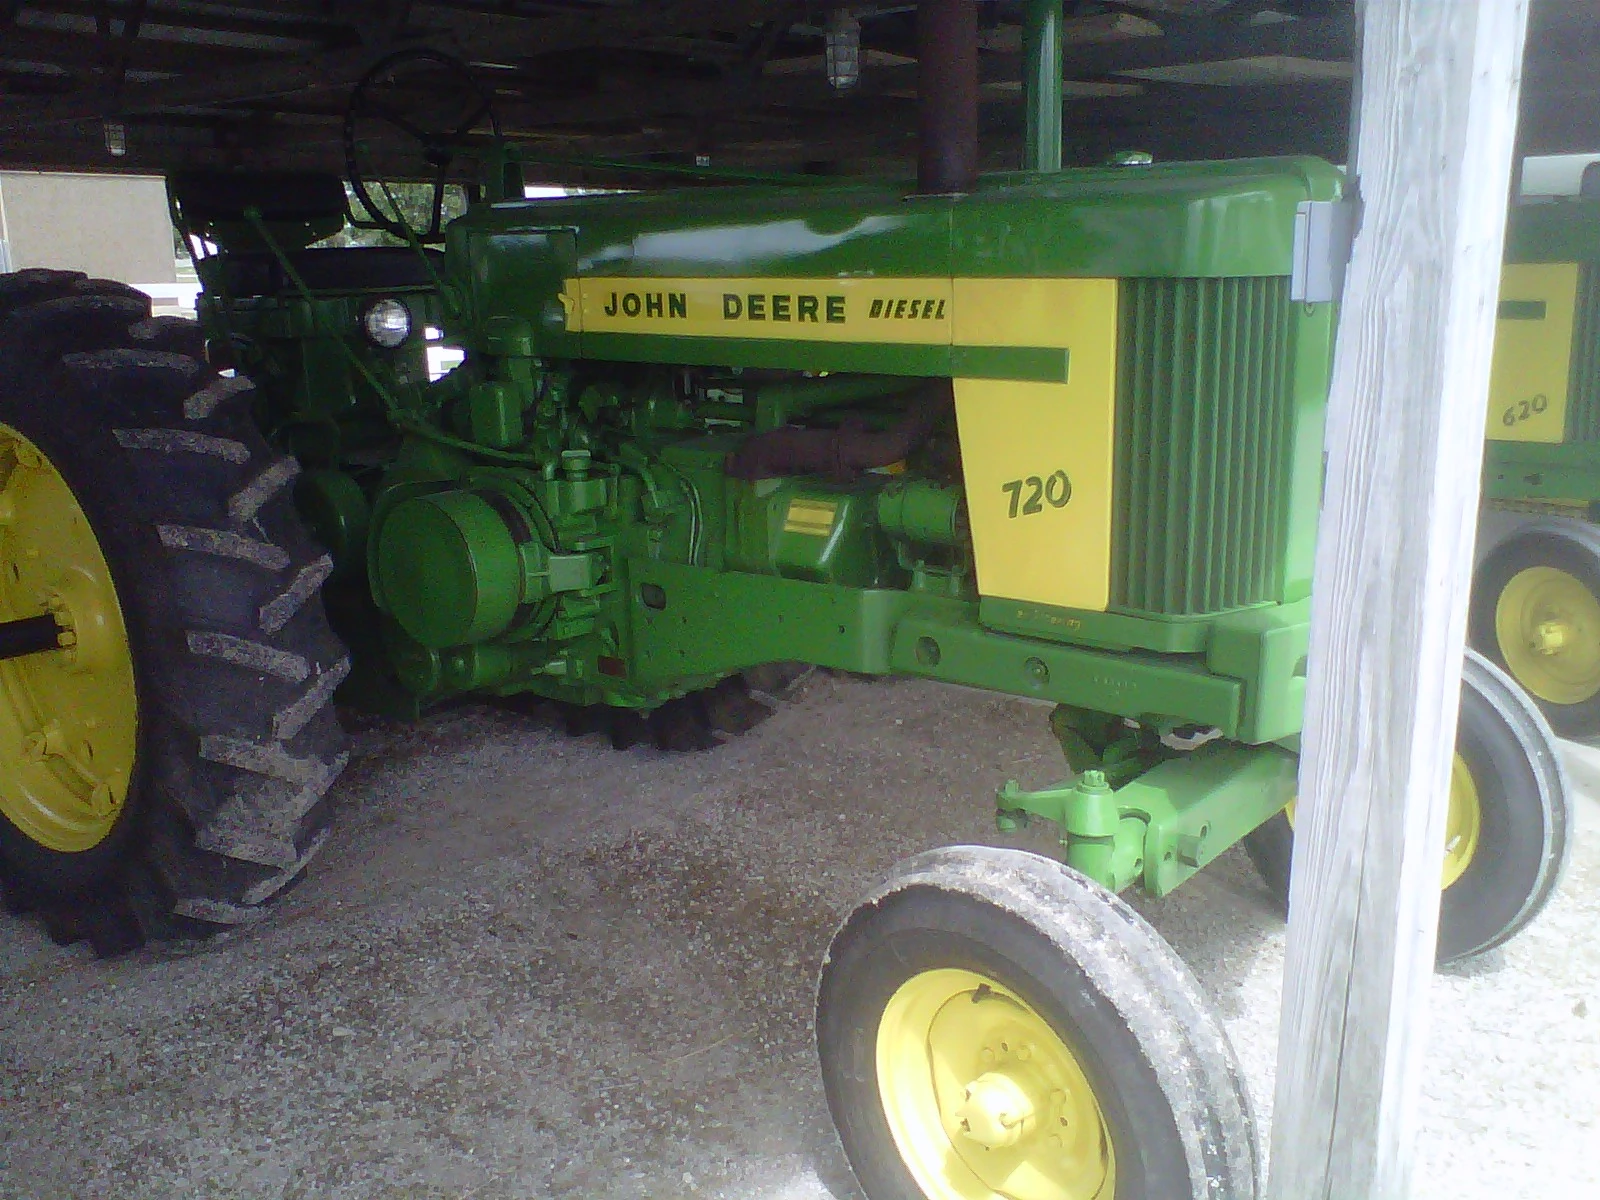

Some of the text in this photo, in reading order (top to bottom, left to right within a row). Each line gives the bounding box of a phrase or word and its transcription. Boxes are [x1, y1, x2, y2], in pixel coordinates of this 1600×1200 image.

[604, 292, 946, 323] JOHN DEERE DIESEL
[1502, 393, 1548, 427] 620
[1002, 469, 1072, 518] 720
